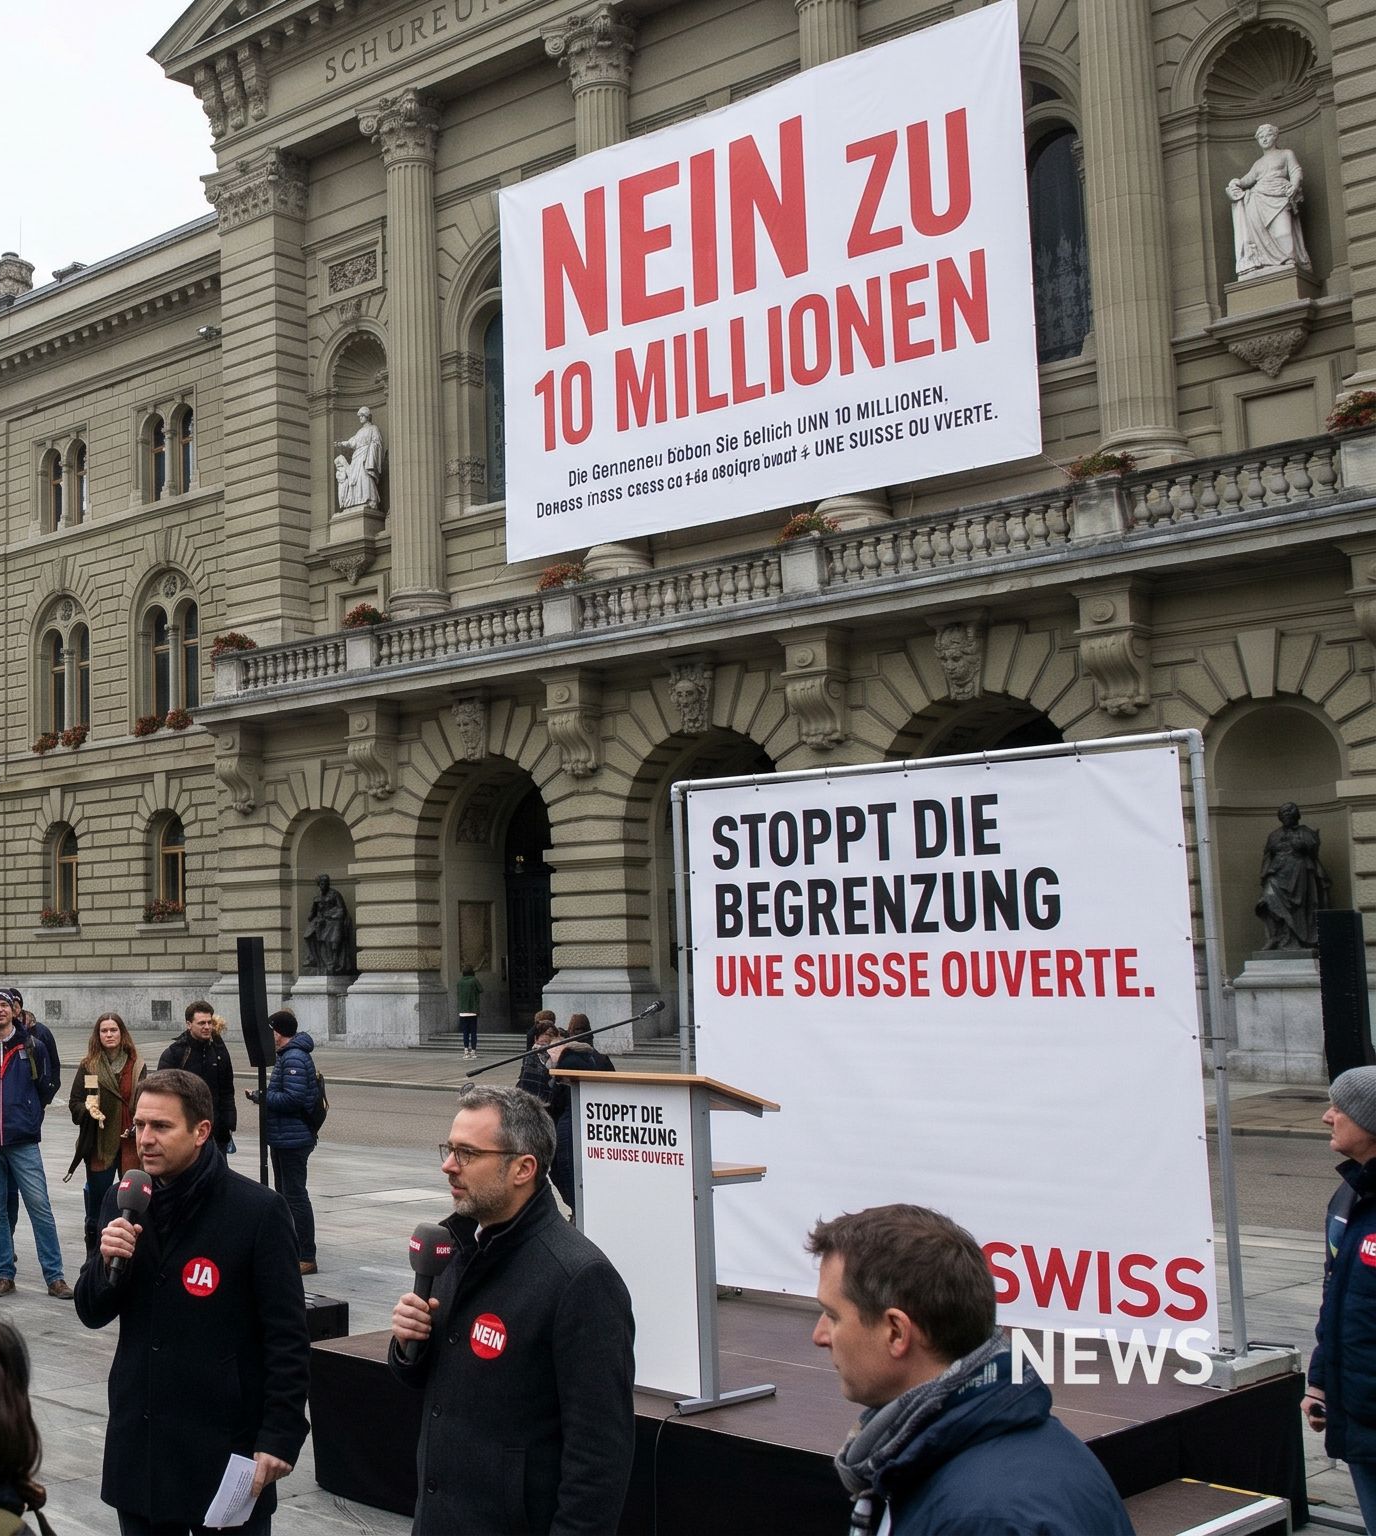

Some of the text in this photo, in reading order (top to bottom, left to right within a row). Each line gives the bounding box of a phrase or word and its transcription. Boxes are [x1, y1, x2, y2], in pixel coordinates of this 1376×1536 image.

[325, 0, 505, 84] SCHUREU
[541, 107, 972, 351] NEIN ZU
[534, 248, 990, 452] 10 MILLIONEN
[568, 468, 588, 487] Die
[716, 434, 739, 453] Sie
[797, 411, 829, 434] UNN
[835, 406, 851, 425] 10
[815, 435, 845, 456] UNE
[849, 422, 904, 450] SUISSE
[909, 418, 929, 436] OU
[712, 793, 1001, 871] STOPPT DIE
[715, 867, 1061, 938] BEGRENZUNG
[715, 947, 1155, 998] UNE SUISSE OUVERTE.
[586, 1102, 663, 1124] STOPPT DIE
[587, 1124, 677, 1147] BEGRENZUNG
[587, 1147, 685, 1166] UNE SUISSE OUVERTE
[187, 1263, 213, 1288] JA
[981, 1241, 1208, 1322] SWISS
[472, 1322, 505, 1351] NEIN
